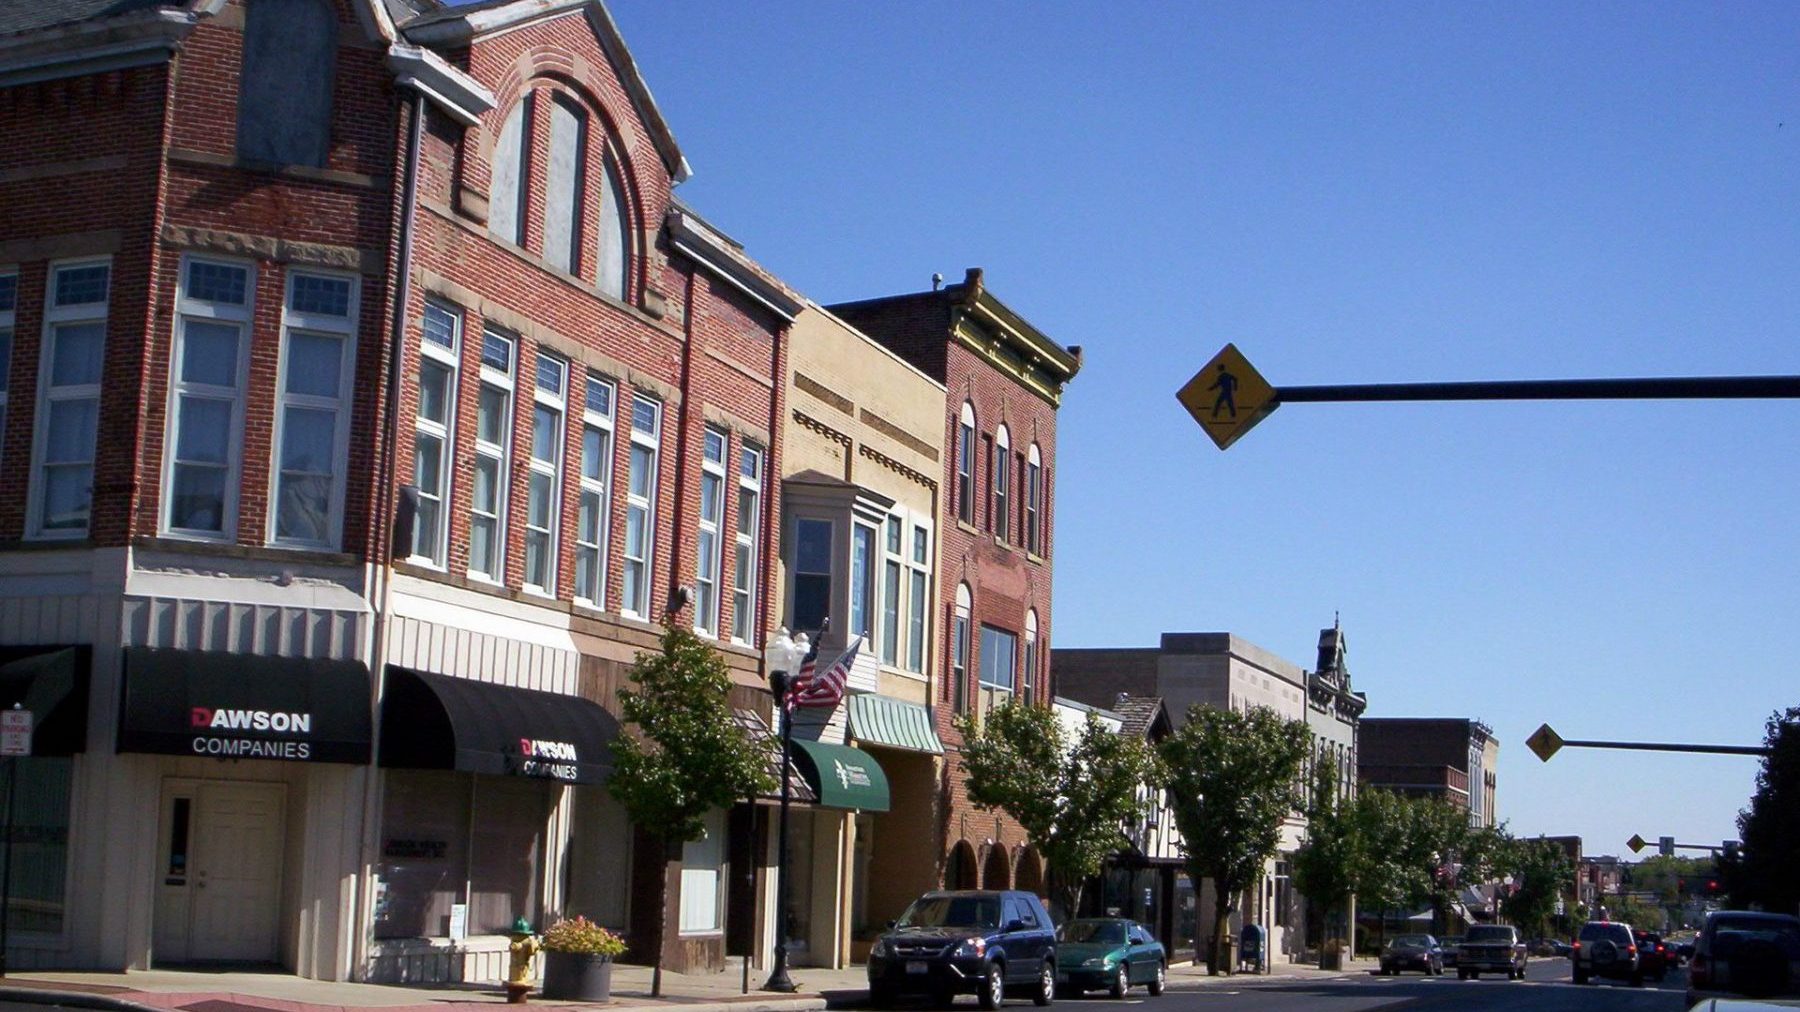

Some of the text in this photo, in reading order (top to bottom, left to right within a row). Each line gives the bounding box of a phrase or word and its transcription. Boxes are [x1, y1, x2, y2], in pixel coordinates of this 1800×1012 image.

[191, 707, 310, 732] DAWSON
[193, 737, 310, 758] COMPANIES
[520, 738, 577, 761] DAWSON
